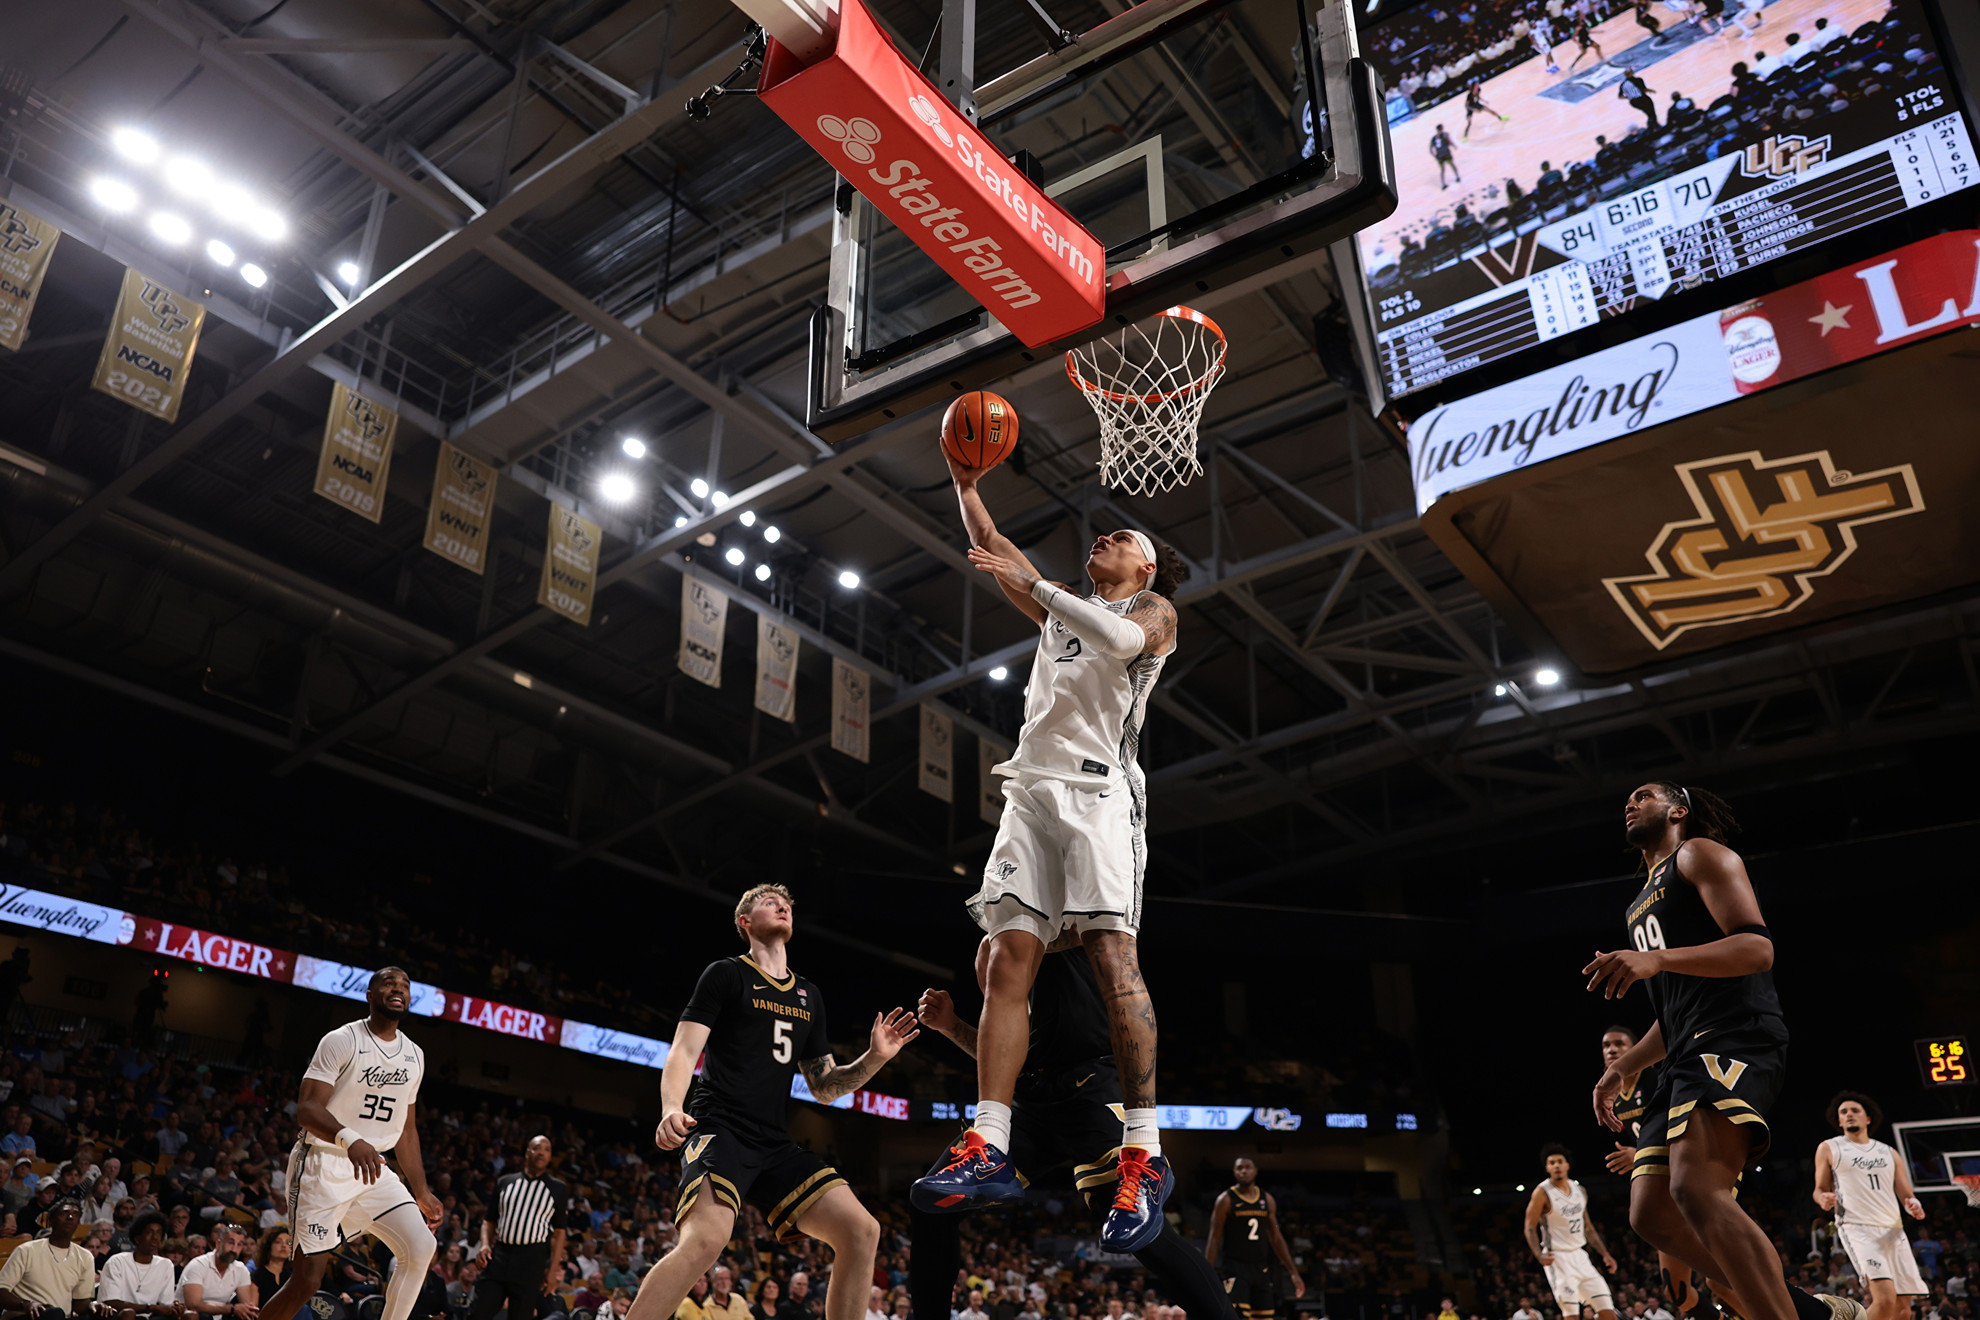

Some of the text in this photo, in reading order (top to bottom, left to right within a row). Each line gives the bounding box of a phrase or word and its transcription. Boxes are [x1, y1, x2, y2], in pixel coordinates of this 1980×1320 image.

[1895, 84, 1941, 107] 1 TOL
[1897, 95, 1944, 121] 5 FLS
[1893, 115, 1956, 145] FLS PTS
[1939, 127, 1955, 140] 21
[1946, 139, 1956, 150] 5
[1743, 135, 1828, 177] UCF
[1905, 143, 1912, 151] 1
[1908, 155, 1918, 164] 0
[1951, 151, 1961, 161] 6
[1913, 167, 1920, 175] 1
[1918, 178, 1924, 187] 1
[1951, 162, 1968, 175] 12
[1958, 175, 1968, 186] 7
[1675, 176, 1712, 207] 70
[1713, 178, 1797, 215] ON THE FLOOR
[1920, 190, 1931, 200] 0
[956, 133, 1093, 285] State Farm
[1607, 190, 1659, 226] 6:16
[1713, 203, 1793, 238] 11 PACHECO
[1733, 199, 1774, 219] KUGEL
[868, 159, 1041, 309] State Farm
[1561, 222, 1596, 251] 84
[1610, 224, 1674, 252] TEAM STATS
[1622, 216, 1654, 236] SECOND
[1715, 213, 1798, 252] 22 JOHNSON
[1743, 220, 1815, 253] CAMBRIDGE
[1720, 243, 1787, 275] 99 BURKS
[138, 277, 192, 334] UCF
[1379, 295, 1404, 310] TOL
[1381, 299, 1421, 322] FLS 10
[122, 322, 185, 360] Basketball
[130, 315, 183, 349] Women's
[117, 344, 174, 384] NCAA
[105, 370, 173, 412] 2021
[346, 389, 387, 440] UCF
[988, 402, 1004, 444] ELITE
[333, 454, 373, 485] NCAA
[324, 477, 376, 513] 2019
[439, 509, 481, 539] WNIT
[432, 532, 480, 565] 2018
[1613, 457, 1914, 642] UCF
[552, 567, 588, 594] WNIT
[547, 587, 587, 617] 2017
[1054, 637, 1082, 663] 2
[1627, 886, 1666, 928] ANDERBILT
[156, 922, 273, 978] LAGER
[459, 996, 546, 1041] LAGER
[752, 998, 811, 1022] VANDERBILT
[772, 1018, 794, 1065] 5
[1928, 1040, 1964, 1057] 6:16
[357, 1066, 411, 1089] Knights
[1699, 1053, 1749, 1091] V
[1929, 1055, 1966, 1082] 25
[359, 1094, 397, 1123] 35
[1206, 1110, 1229, 1127] 70
[1851, 1156, 1888, 1170] Knights
[1867, 1173, 1881, 1191] 11
[1248, 1217, 1259, 1240] 2
[1569, 1218, 1581, 1234] 22
